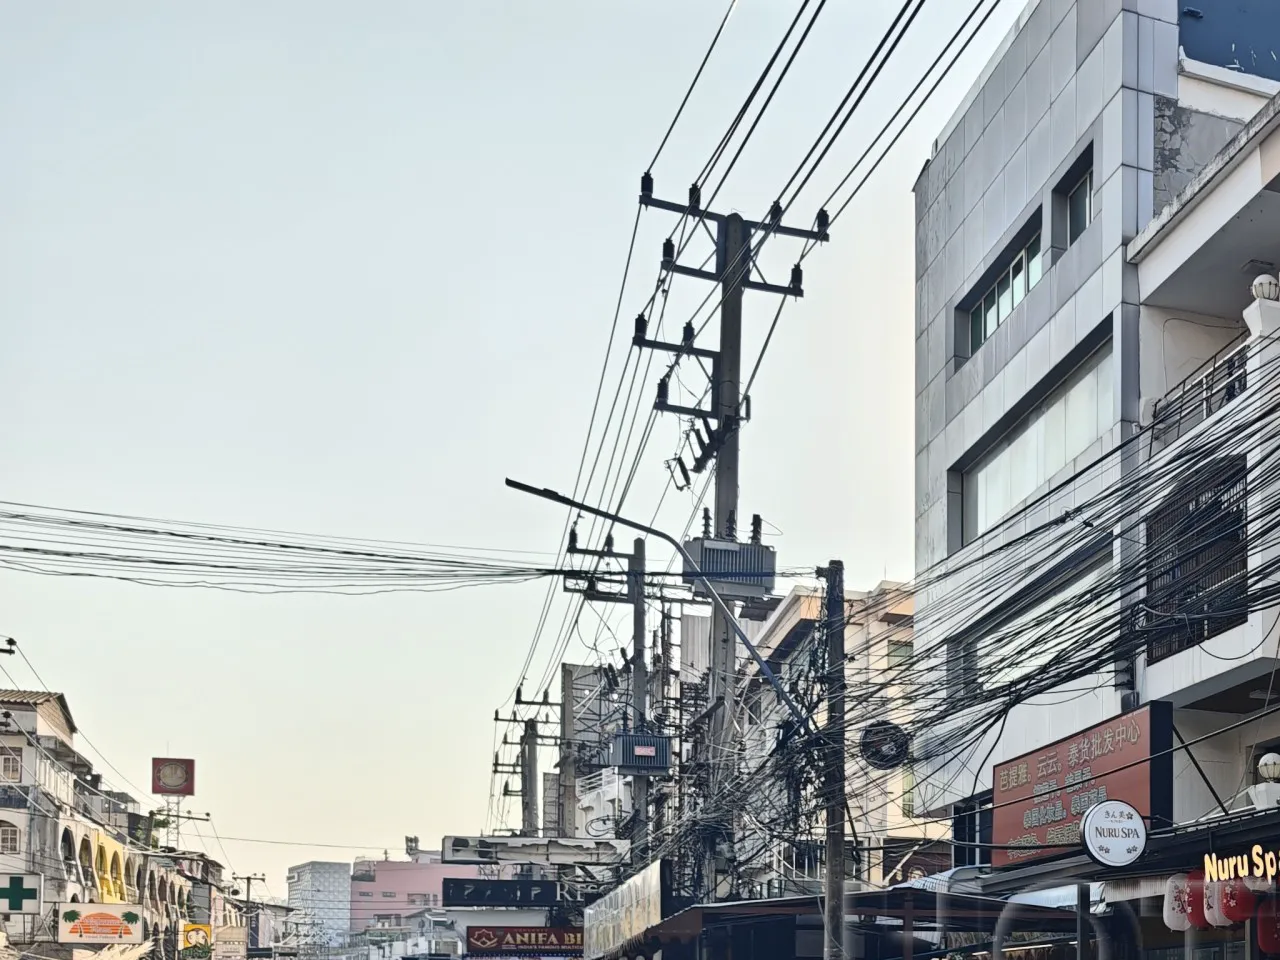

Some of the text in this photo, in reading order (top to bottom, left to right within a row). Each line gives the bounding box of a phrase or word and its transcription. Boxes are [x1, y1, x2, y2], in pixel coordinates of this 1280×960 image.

[1095, 826, 1140, 839] NURU SPA
[1203, 848, 1249, 884] Nuru
[503, 932, 559, 945] ANIFA
